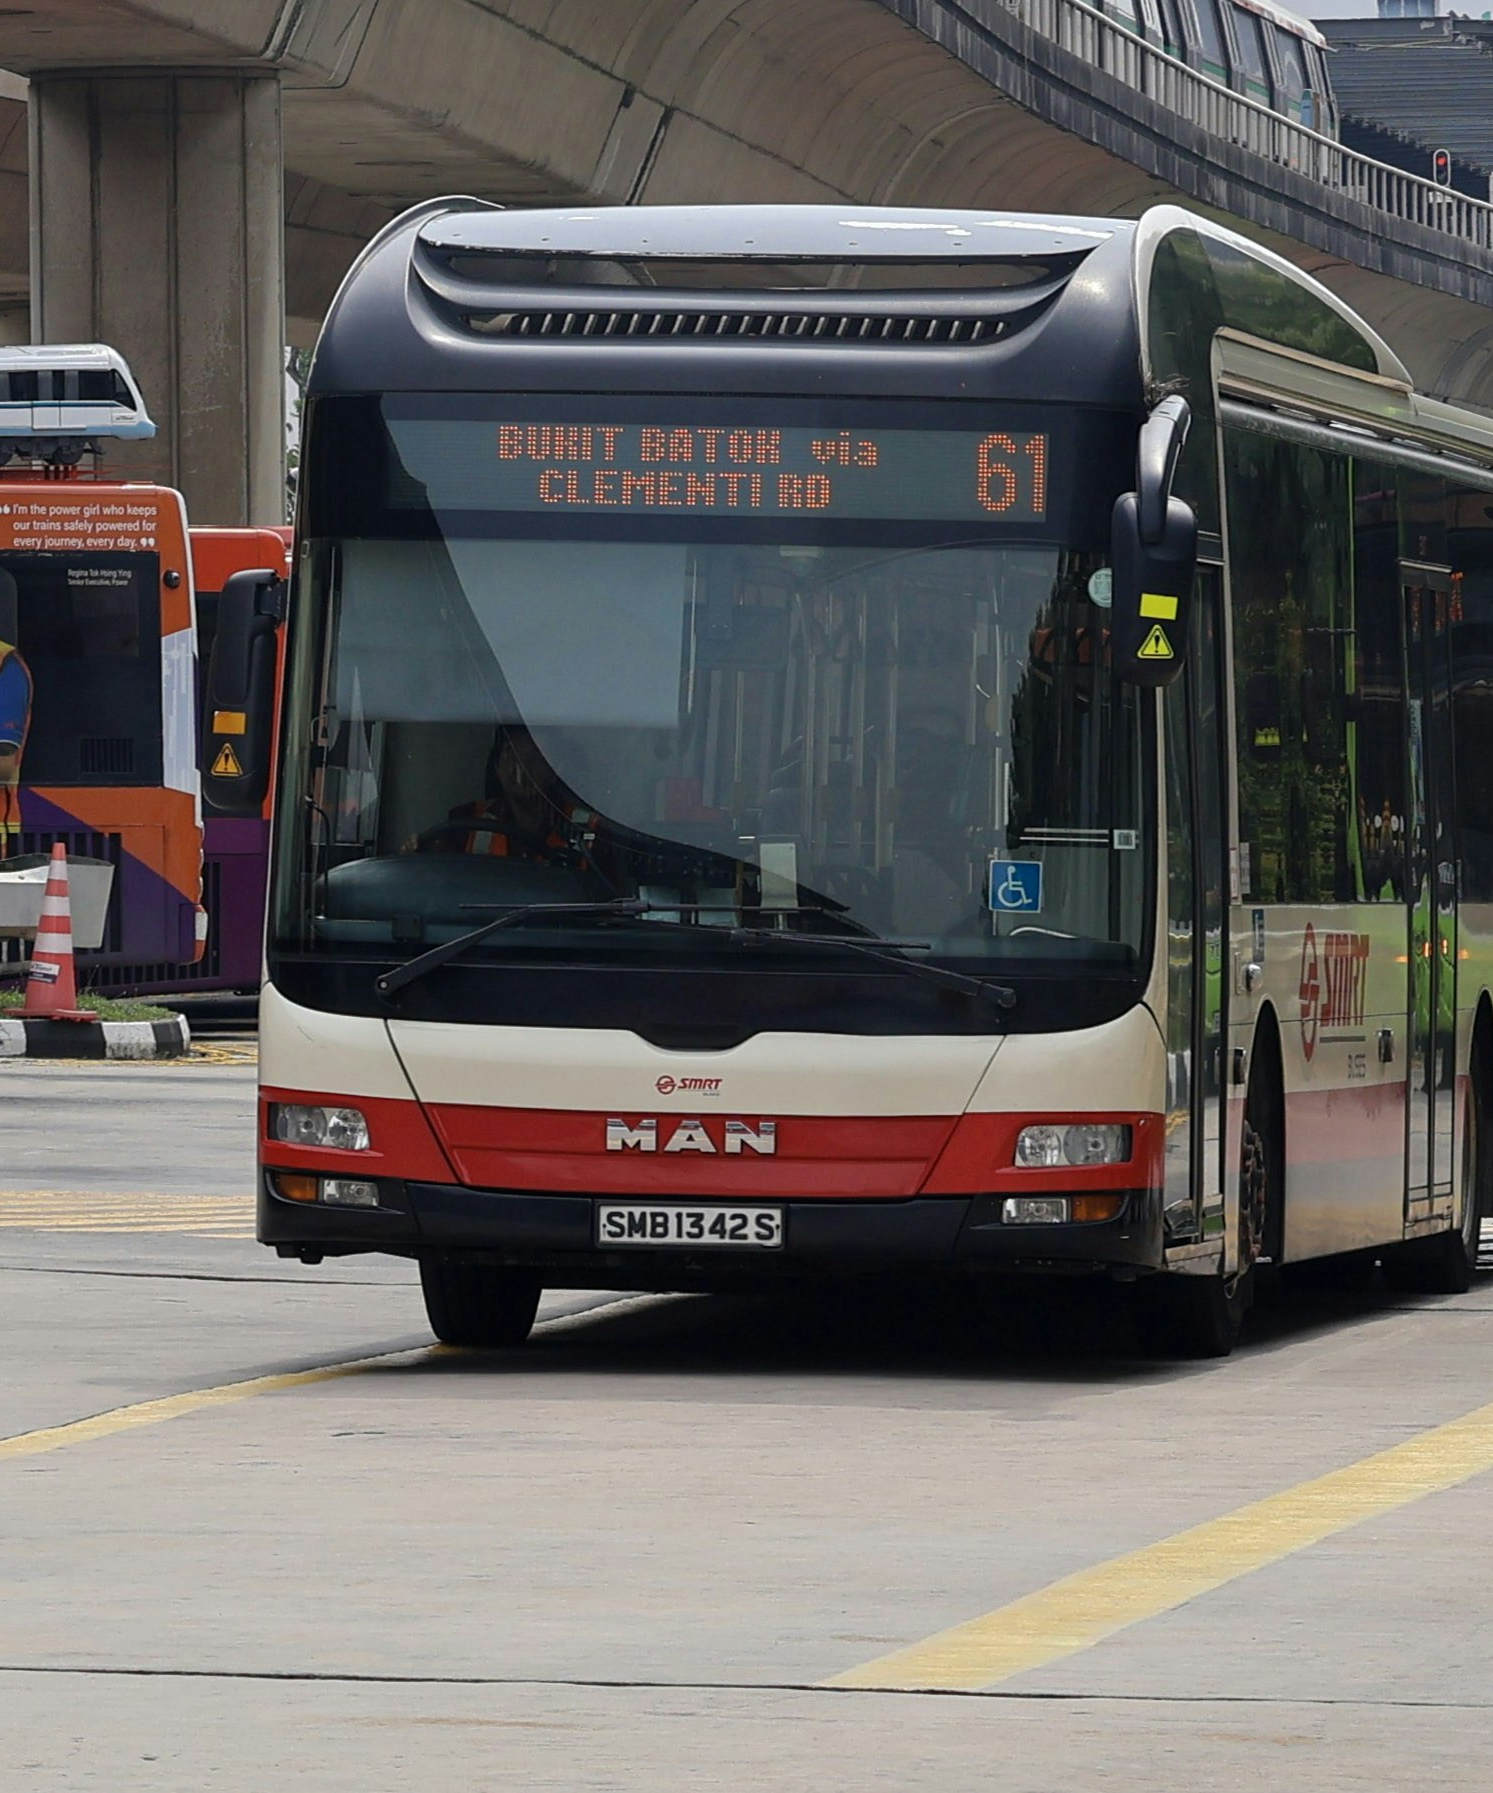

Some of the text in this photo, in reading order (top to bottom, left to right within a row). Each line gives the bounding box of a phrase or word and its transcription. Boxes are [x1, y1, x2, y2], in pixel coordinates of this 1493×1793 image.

[499, 425, 878, 467] BUKIT BATOK via
[539, 469, 831, 508] CLEMENTI RD
[977, 434, 1044, 513] 61
[13, 503, 158, 518] I'm the power girl who keeps
[13, 519, 157, 534] our trains safely powered for
[13, 536, 42, 549] every
[44, 535, 85, 550] journey,
[86, 537, 113, 550] every
[1320, 933, 1370, 1027] SMRT
[677, 1077, 723, 1091] SMRT
[606, 1118, 776, 1154] MAN
[606, 1210, 776, 1241] SMB1342S
